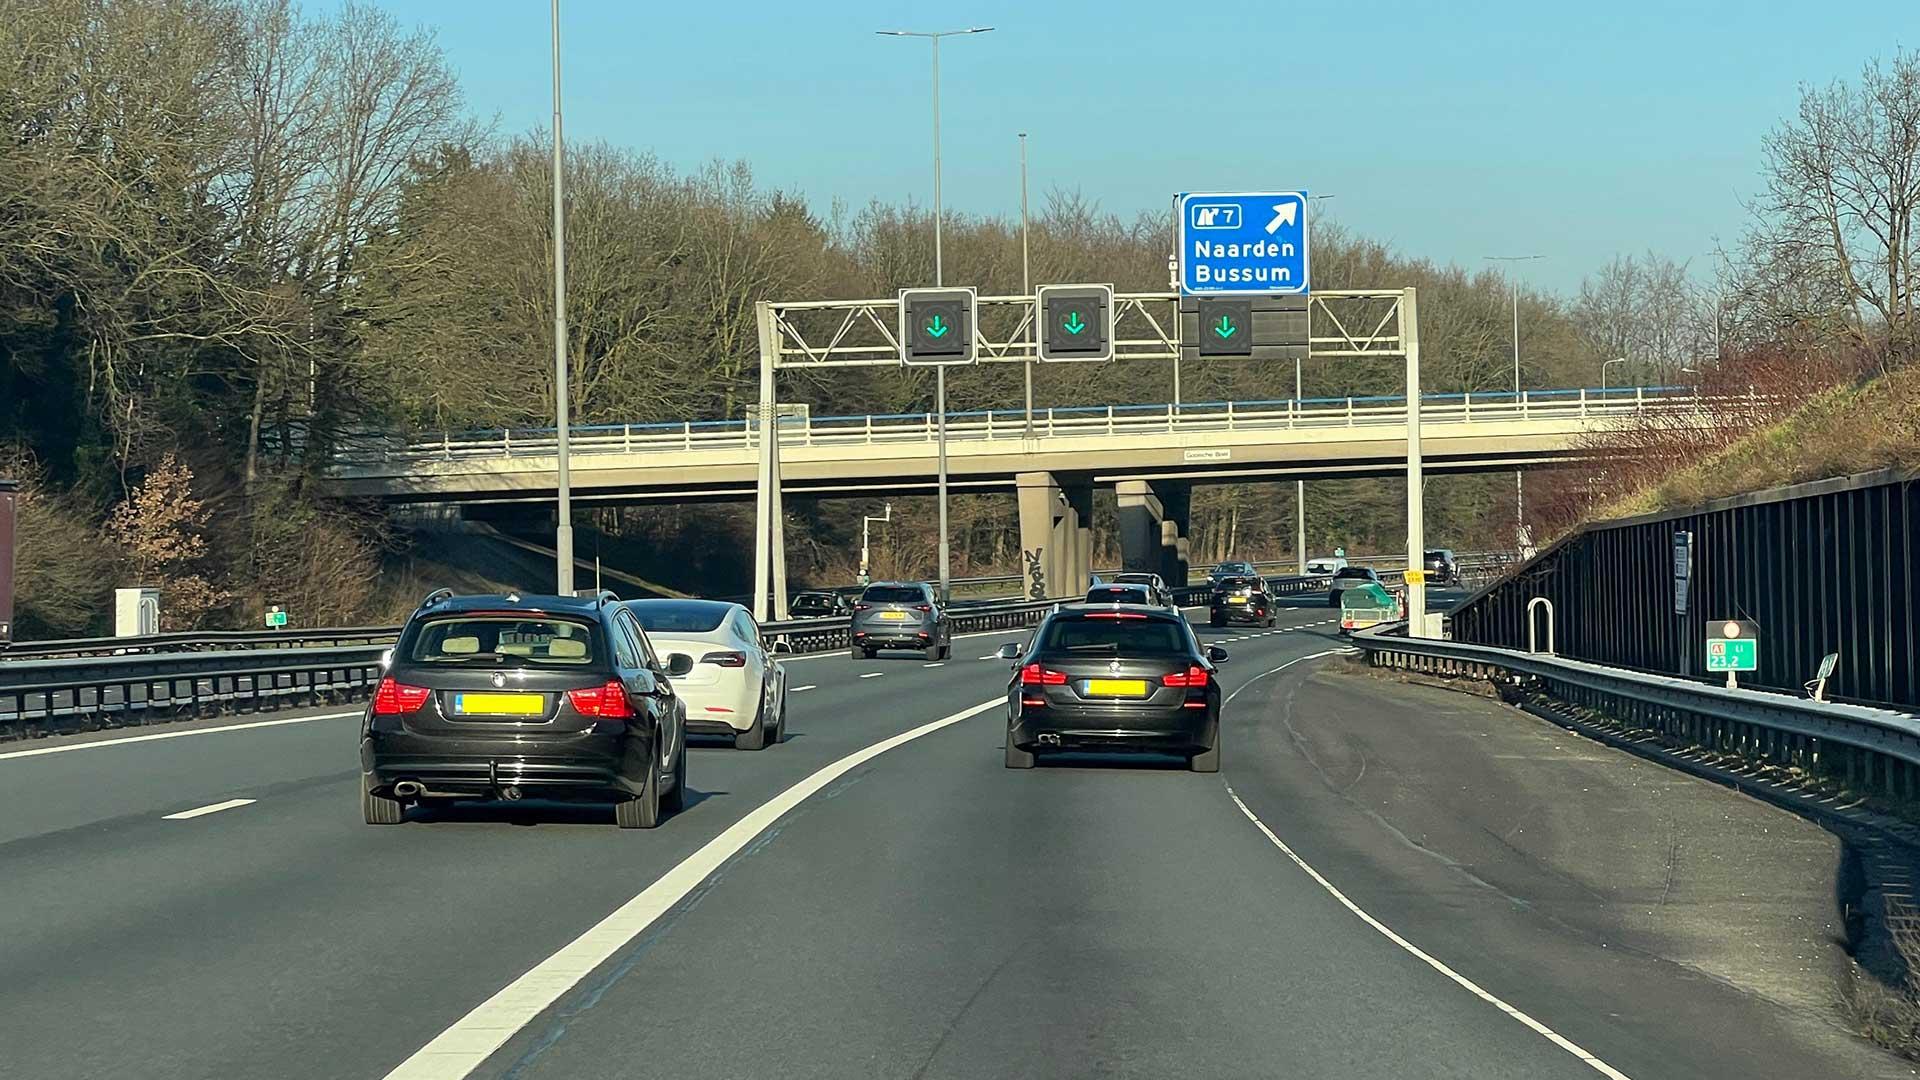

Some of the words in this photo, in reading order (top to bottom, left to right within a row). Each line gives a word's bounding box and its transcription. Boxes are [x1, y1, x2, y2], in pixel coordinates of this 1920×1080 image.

[1222, 209, 1234, 224] 7
[1195, 240, 1295, 258] Naarden
[1195, 265, 1291, 283] Bussum
[1712, 644, 1724, 654] A1
